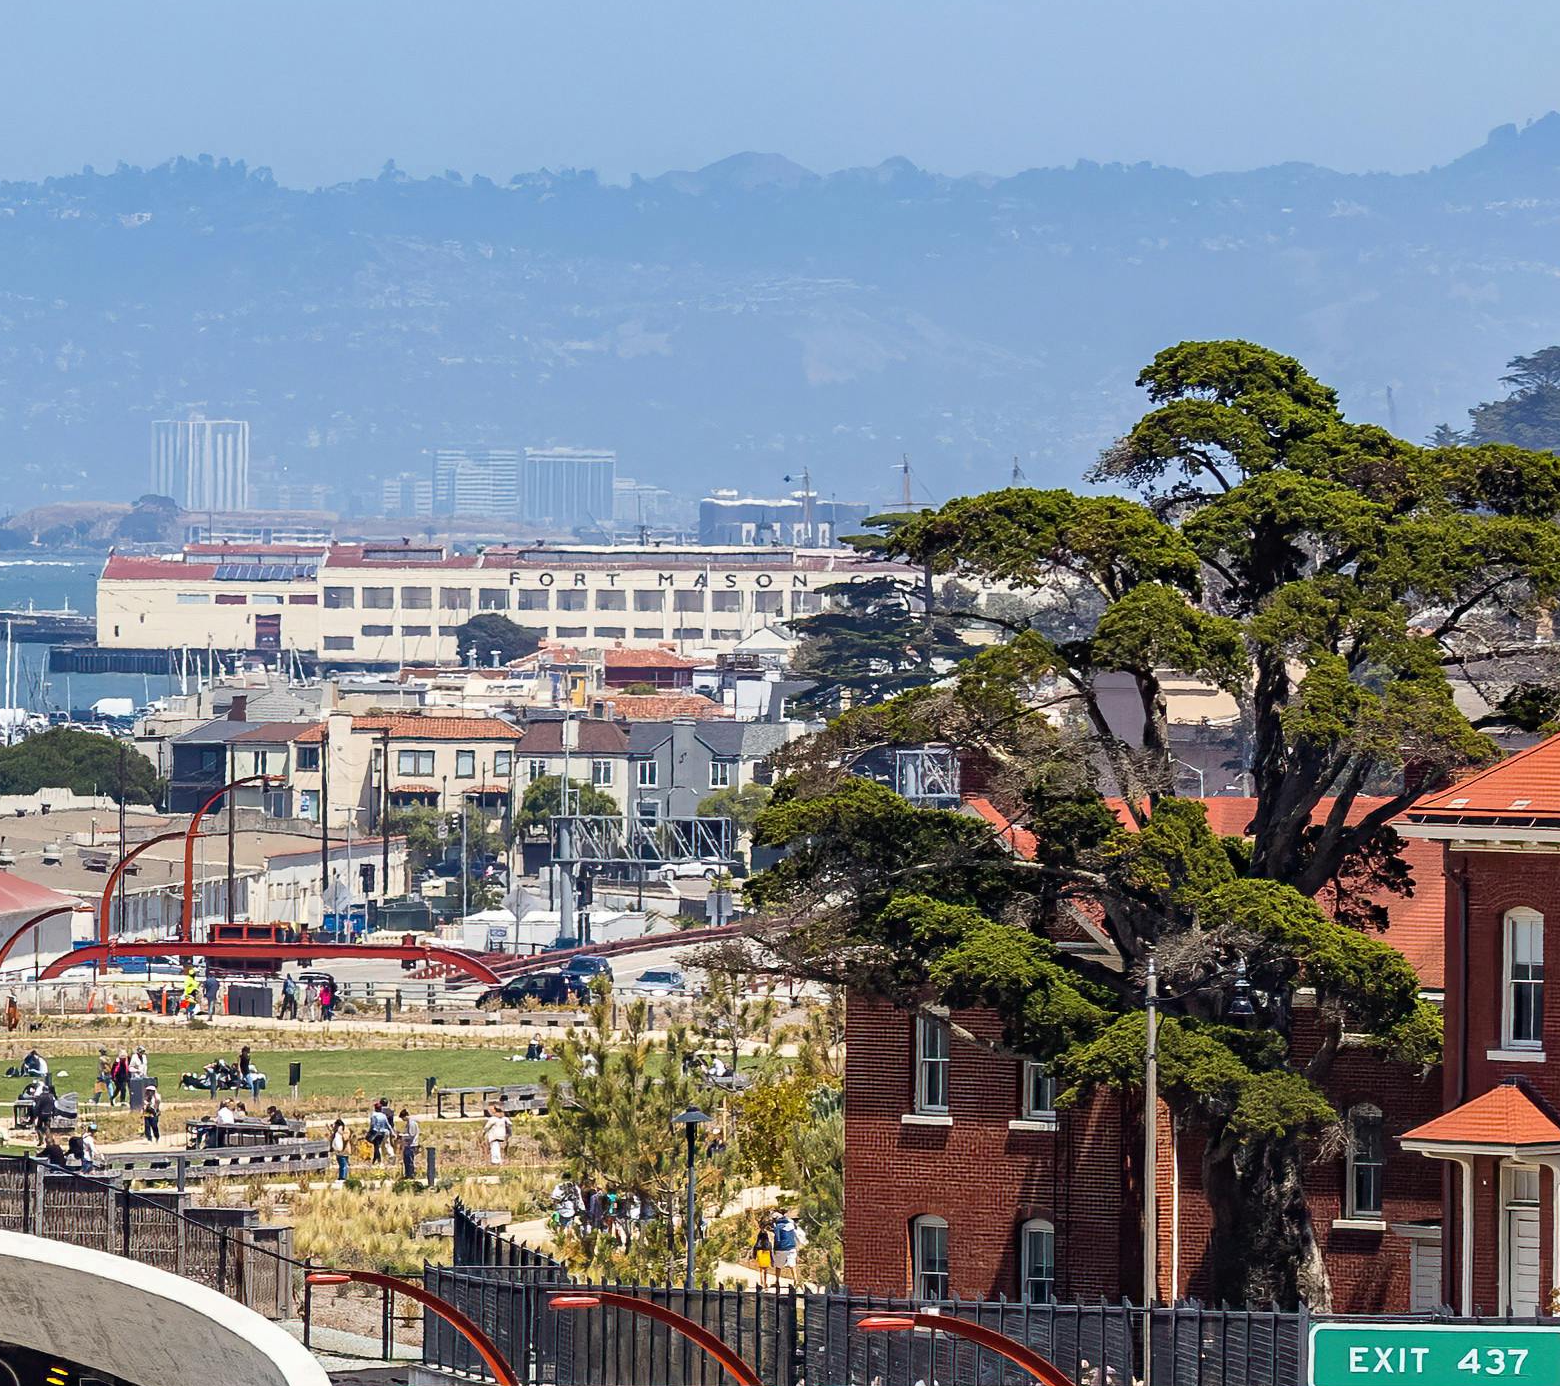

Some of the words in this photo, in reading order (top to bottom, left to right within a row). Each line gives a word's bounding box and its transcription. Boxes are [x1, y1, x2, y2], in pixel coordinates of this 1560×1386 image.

[509, 572, 621, 588] FORT
[658, 572, 809, 589] MASON
[1349, 1346, 1429, 1373] EXIT
[1457, 1348, 1529, 1375] 437
